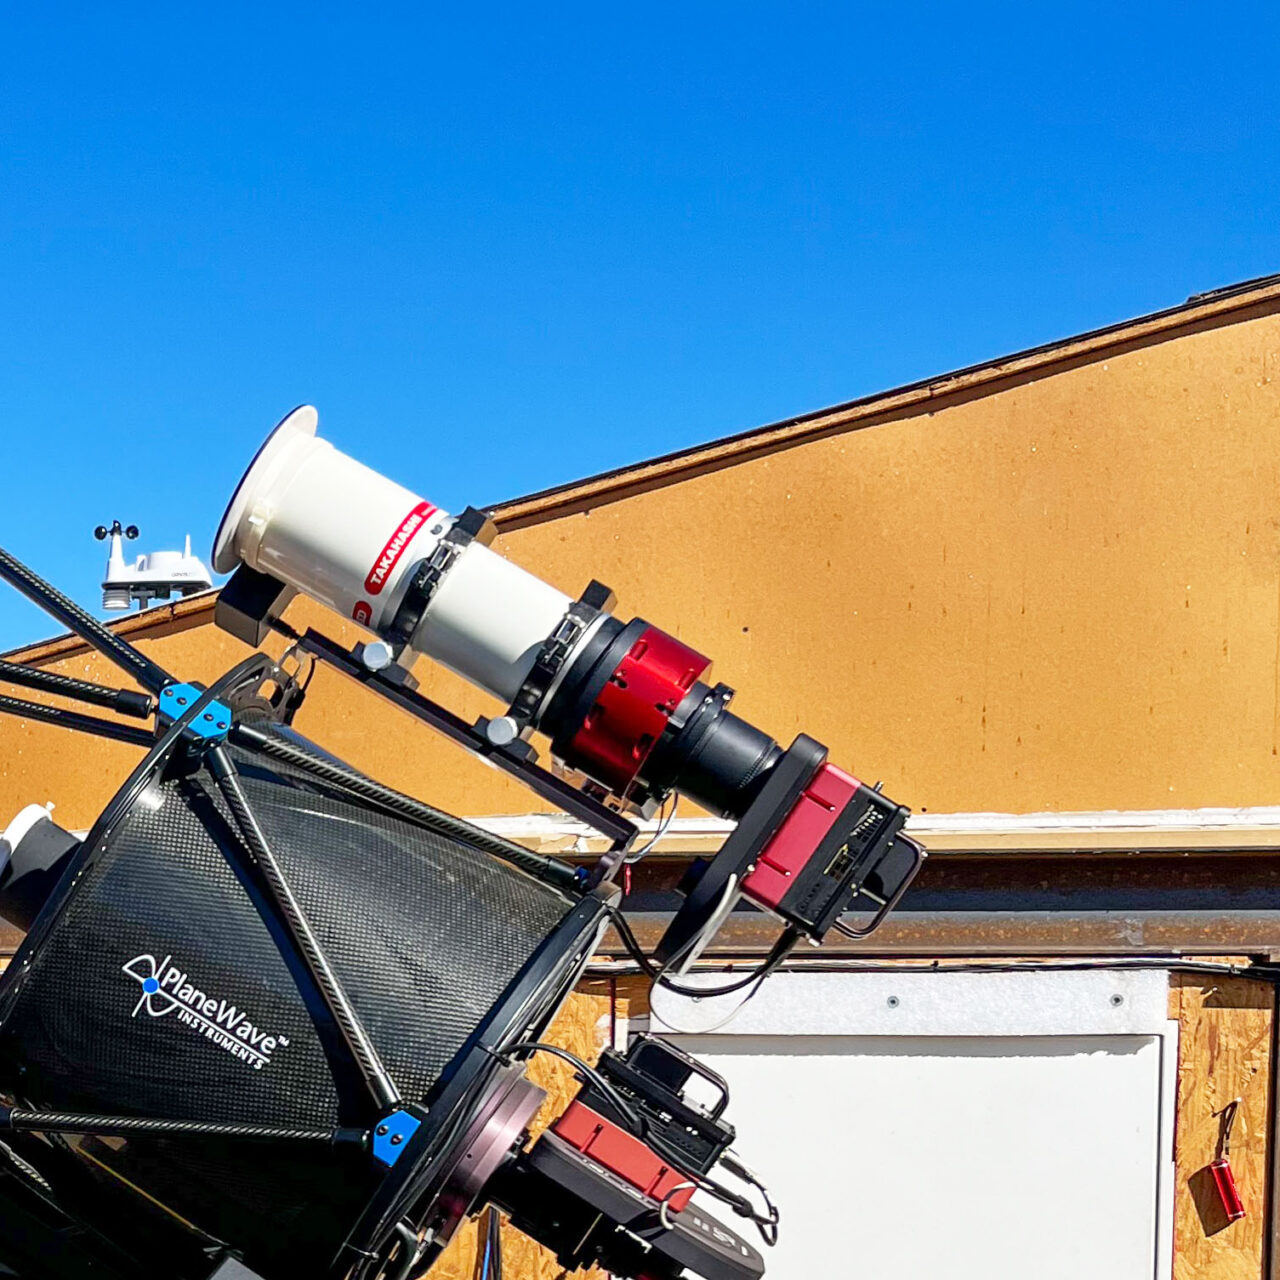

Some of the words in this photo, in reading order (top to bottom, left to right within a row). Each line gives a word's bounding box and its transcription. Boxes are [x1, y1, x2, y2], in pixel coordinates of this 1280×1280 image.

[370, 512, 423, 585] TAKAHASHI
[160, 966, 278, 1054] PlaneWave
[177, 1010, 265, 1070] INSTRUMENTS
